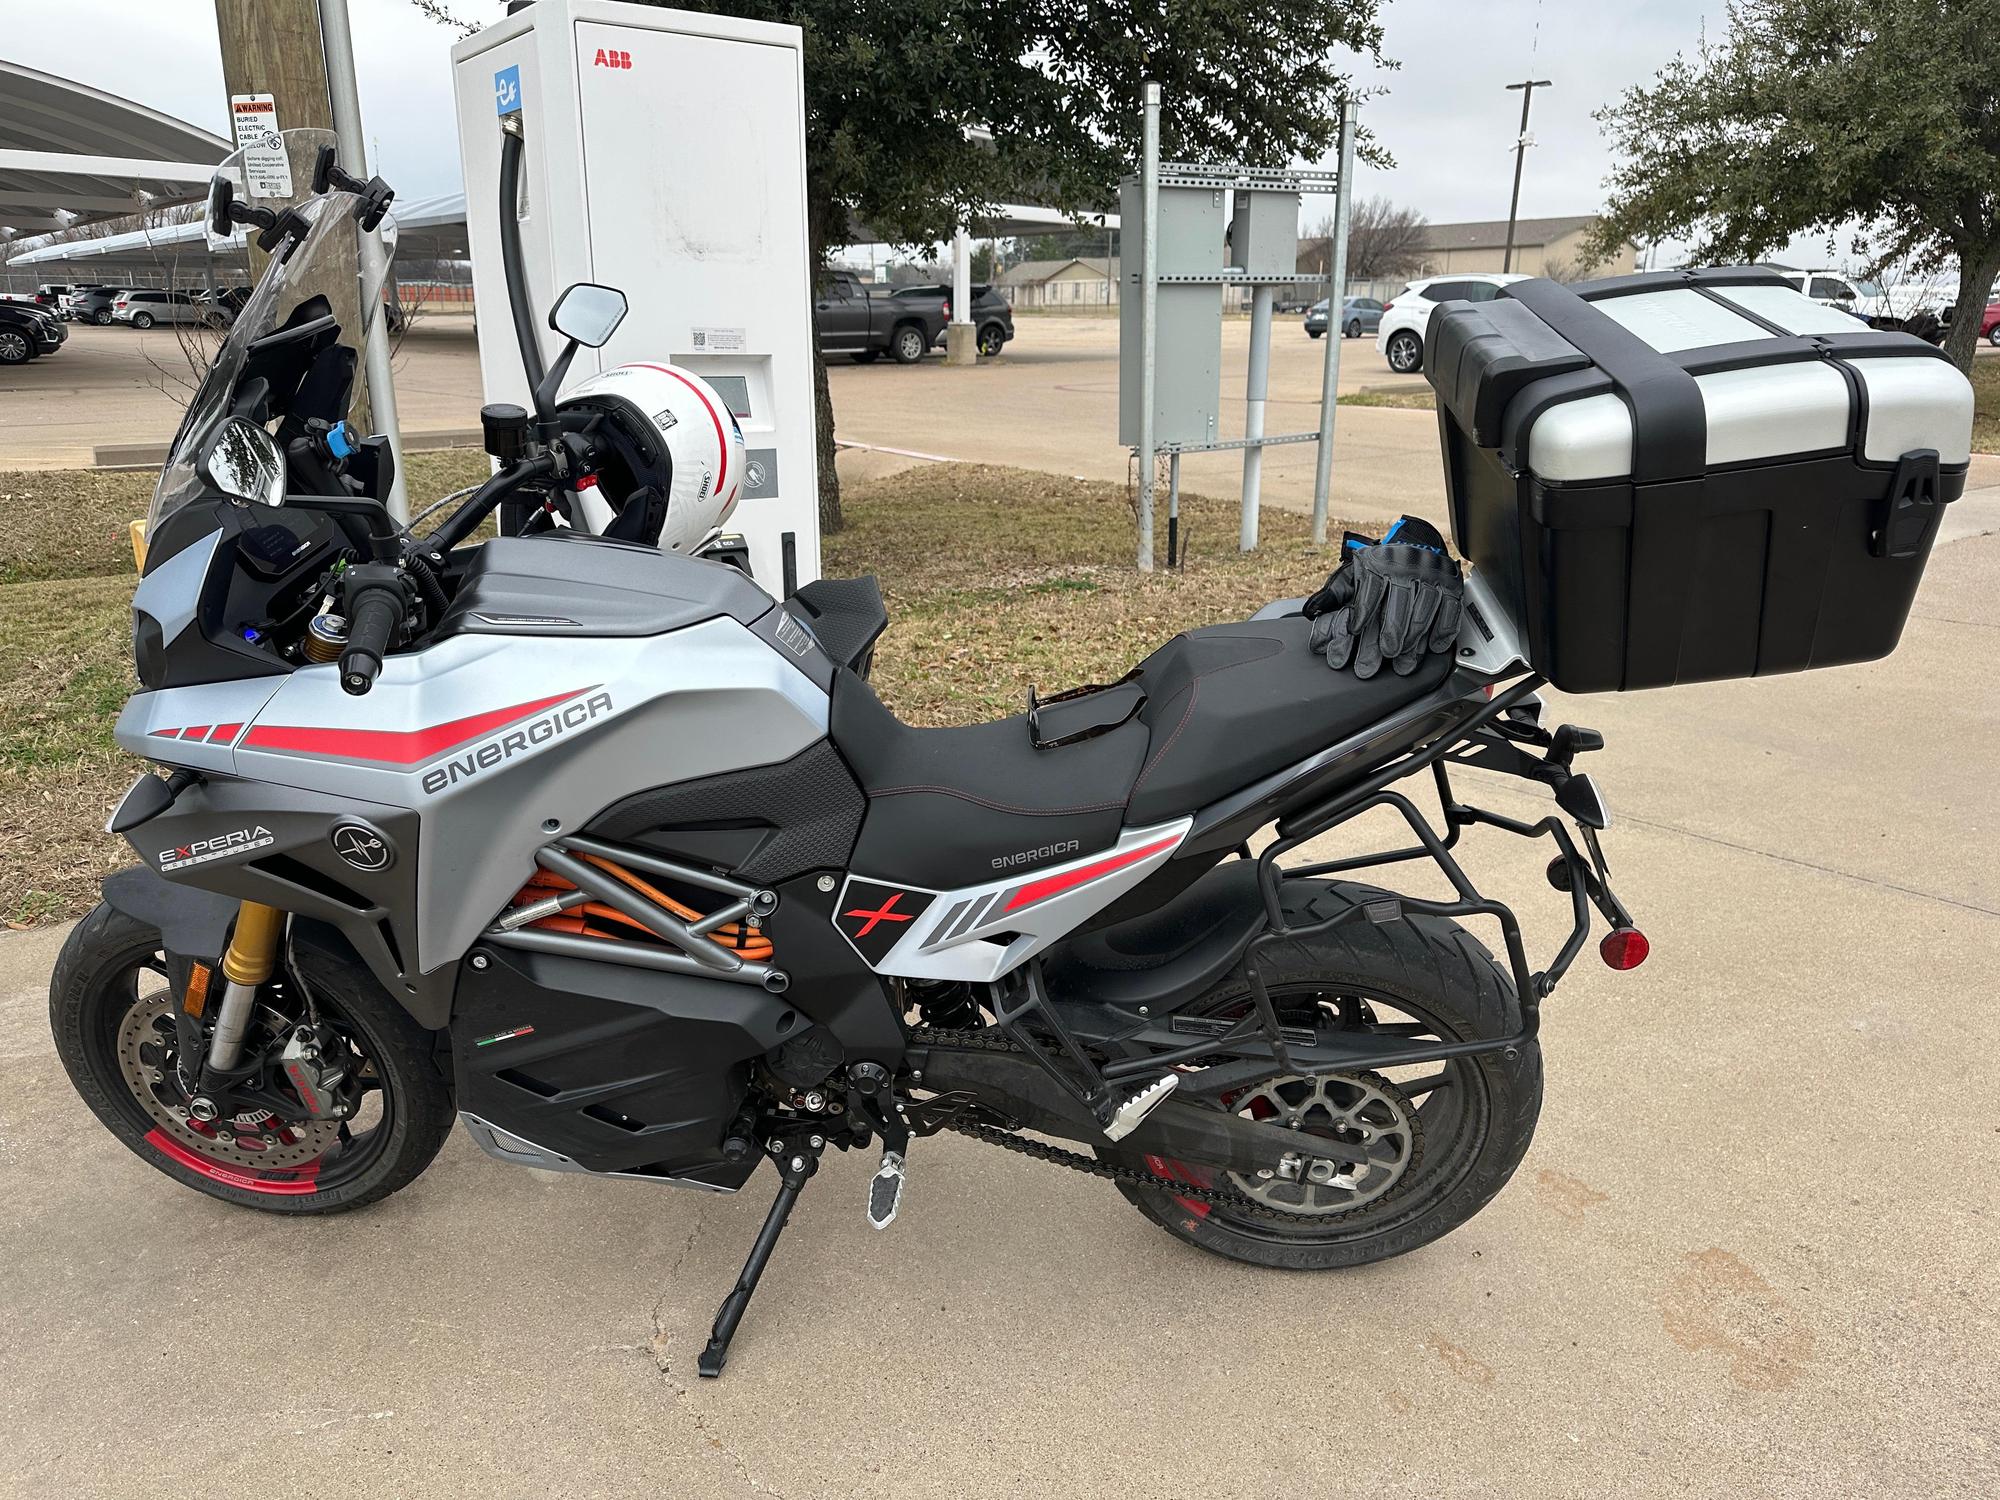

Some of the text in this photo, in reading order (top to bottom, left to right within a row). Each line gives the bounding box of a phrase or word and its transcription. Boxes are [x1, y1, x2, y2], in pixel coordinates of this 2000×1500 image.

[594, 48, 632, 69] ABB
[241, 103, 273, 112] WARNING
[698, 475, 711, 499] SHOEI
[158, 825, 272, 863] EXPERIA
